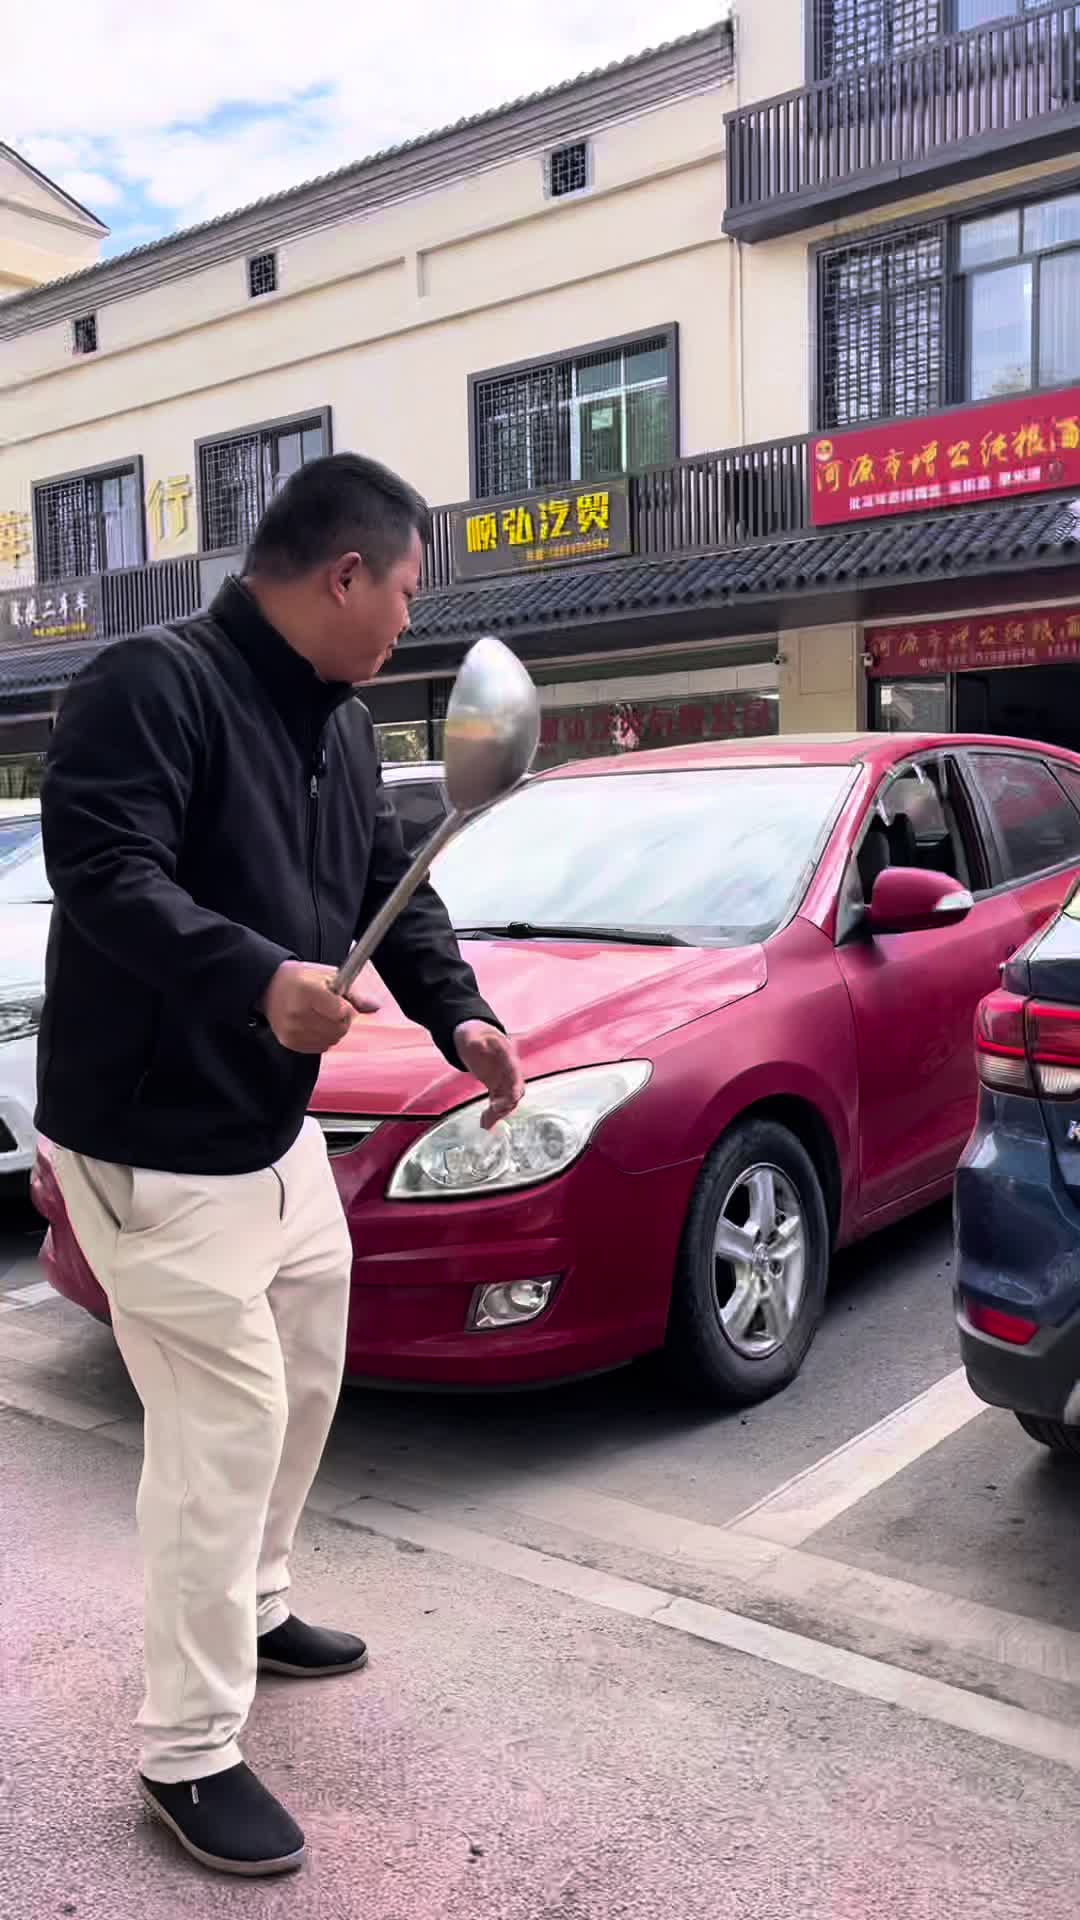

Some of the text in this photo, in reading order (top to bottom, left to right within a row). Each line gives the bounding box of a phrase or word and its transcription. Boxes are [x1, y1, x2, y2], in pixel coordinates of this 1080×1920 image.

[147, 474, 192, 545] 行
[466, 492, 609, 553] 顺弘汽贸
